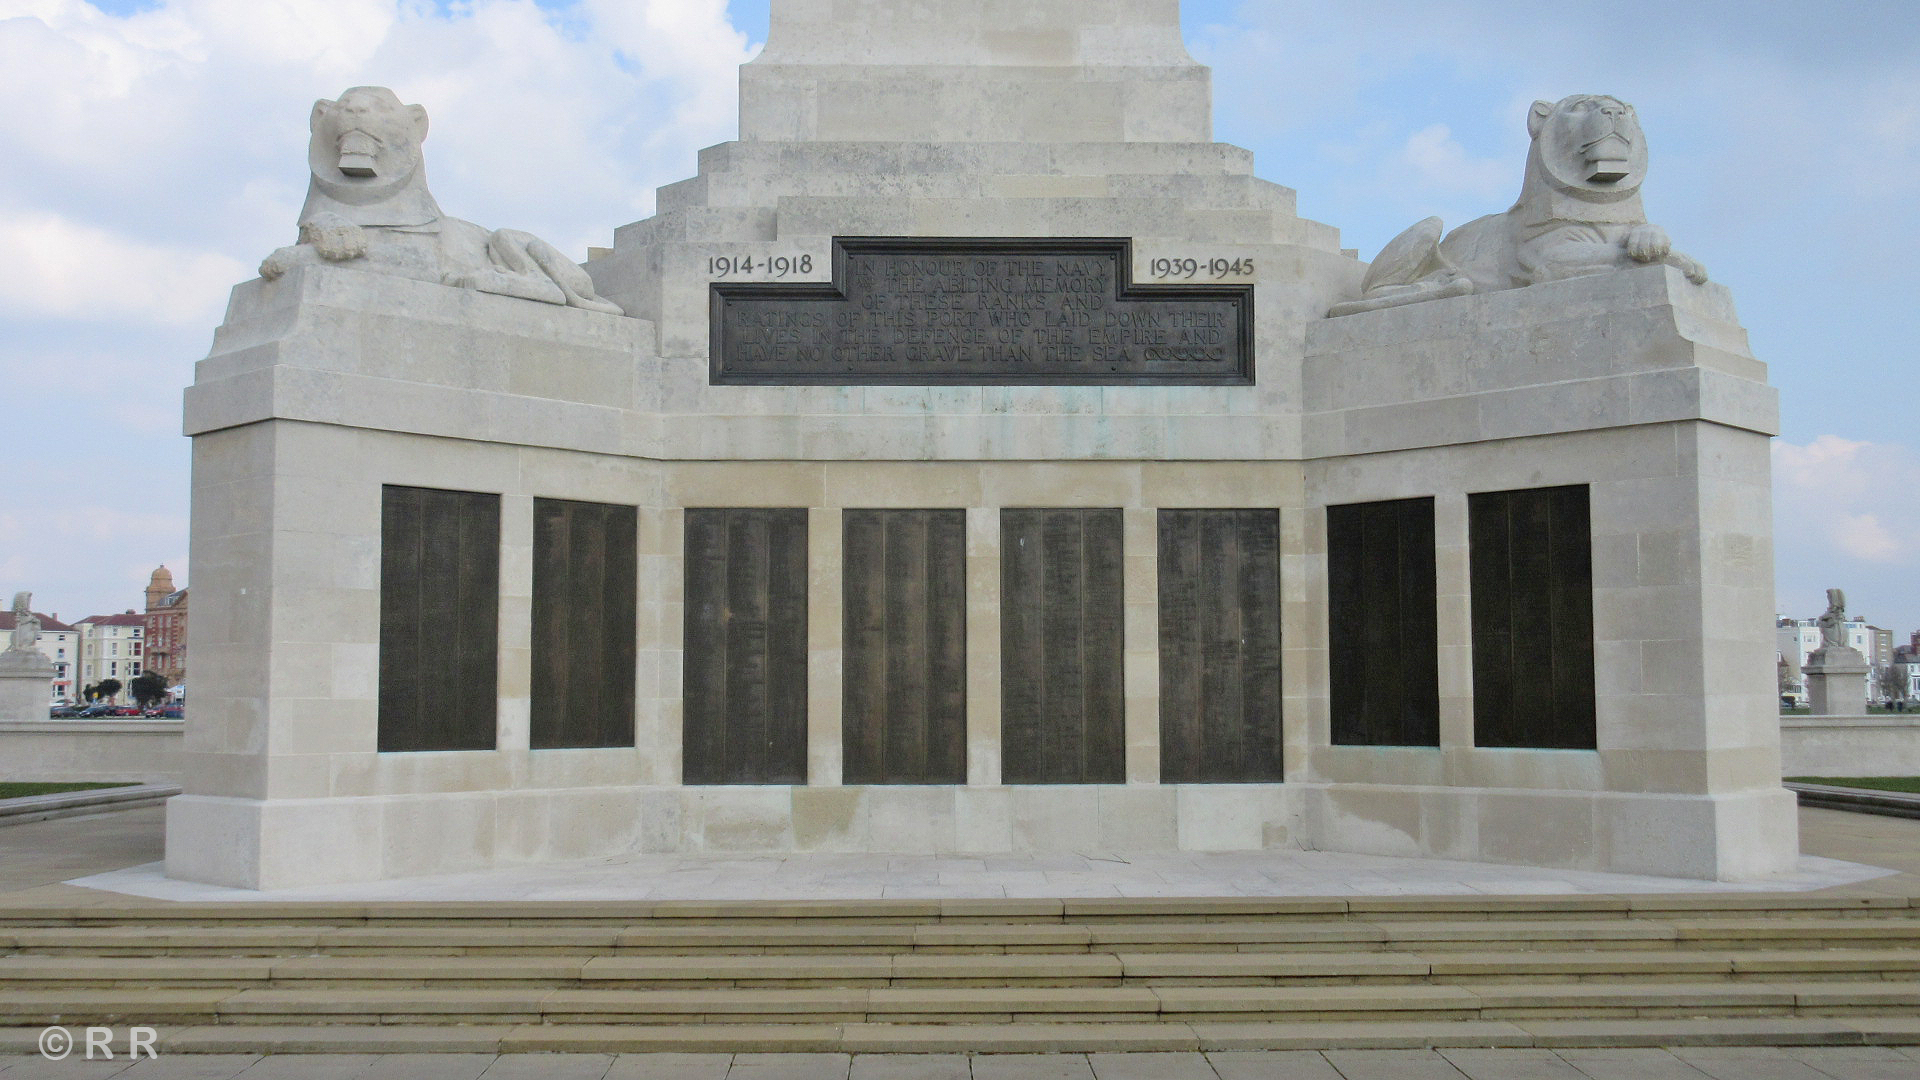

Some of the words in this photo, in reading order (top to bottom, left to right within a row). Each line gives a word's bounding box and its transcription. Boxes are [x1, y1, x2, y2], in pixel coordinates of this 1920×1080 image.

[709, 254, 813, 278] 1914-1918
[855, 260, 875, 277] IN
[885, 260, 966, 277] HONOUR
[974, 260, 998, 277] OF
[1004, 260, 1044, 277] THE
[1056, 260, 1107, 277] NAVY
[1150, 257, 1255, 279] 1939-1945
[886, 278, 926, 293] THE
[933, 278, 1013, 293] ABIDING
[1024, 278, 1106, 293] MEMORY
[861, 294, 886, 310] OF
[895, 294, 963, 310] THESE
[978, 294, 1046, 310] RANKS
[1061, 294, 1104, 310] AND
[736, 311, 825, 327] RATINGS
[836, 311, 860, 327] OF
[869, 311, 916, 327] THIS
[926, 311, 979, 327] PORT
[988, 311, 1031, 327] WHO
[1044, 311, 1091, 327] LAID
[1104, 311, 1161, 327] DOWN
[1168, 311, 1226, 327] THEIR
[812, 328, 832, 344] IN
[839, 328, 881, 344] THE
[893, 328, 986, 344] DEFENCE
[999, 328, 1024, 344] OF
[1032, 328, 1074, 344] THE
[1088, 328, 1168, 344] EMPIRE
[1178, 328, 1221, 344] AND
[736, 345, 794, 362] HAVE
[831, 345, 895, 362] OTHER
[905, 345, 972, 362] GRAVE
[979, 345, 1033, 362] THAN
[1041, 345, 1081, 362] THE
[1092, 345, 1132, 362] SEA
